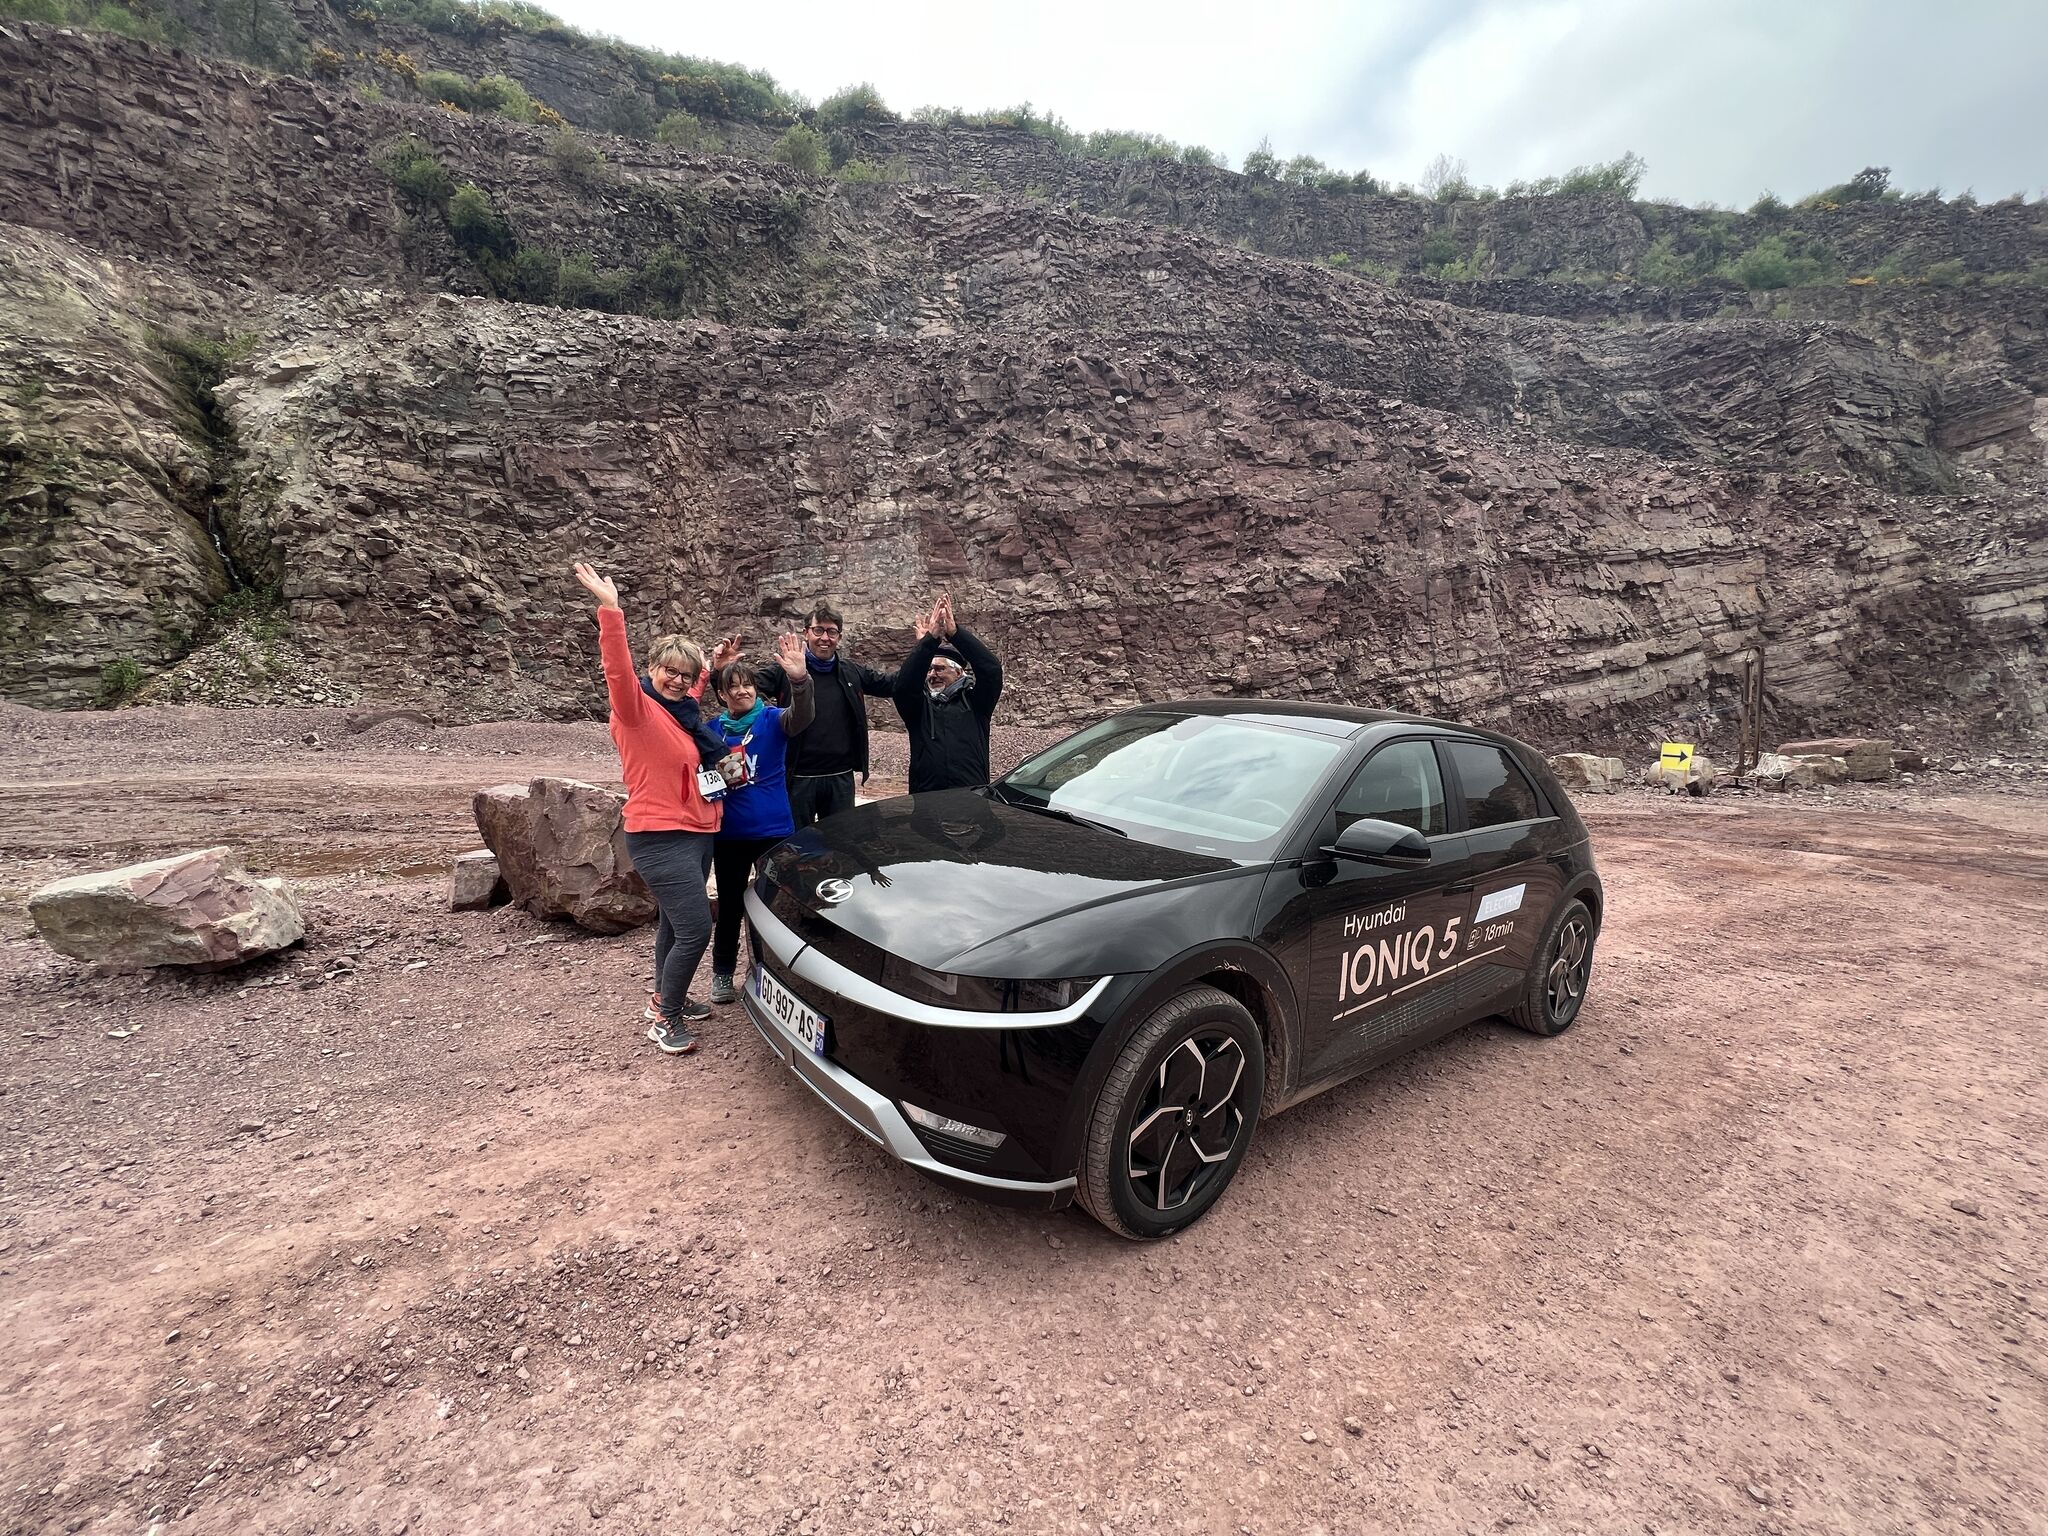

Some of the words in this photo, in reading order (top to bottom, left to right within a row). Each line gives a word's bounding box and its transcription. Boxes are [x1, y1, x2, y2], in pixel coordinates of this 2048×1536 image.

[1343, 899, 1407, 938] Hyundai
[1484, 920, 1514, 943] 18min
[1338, 925, 1435, 1002] IONIQ
[1438, 916, 1461, 960] 5
